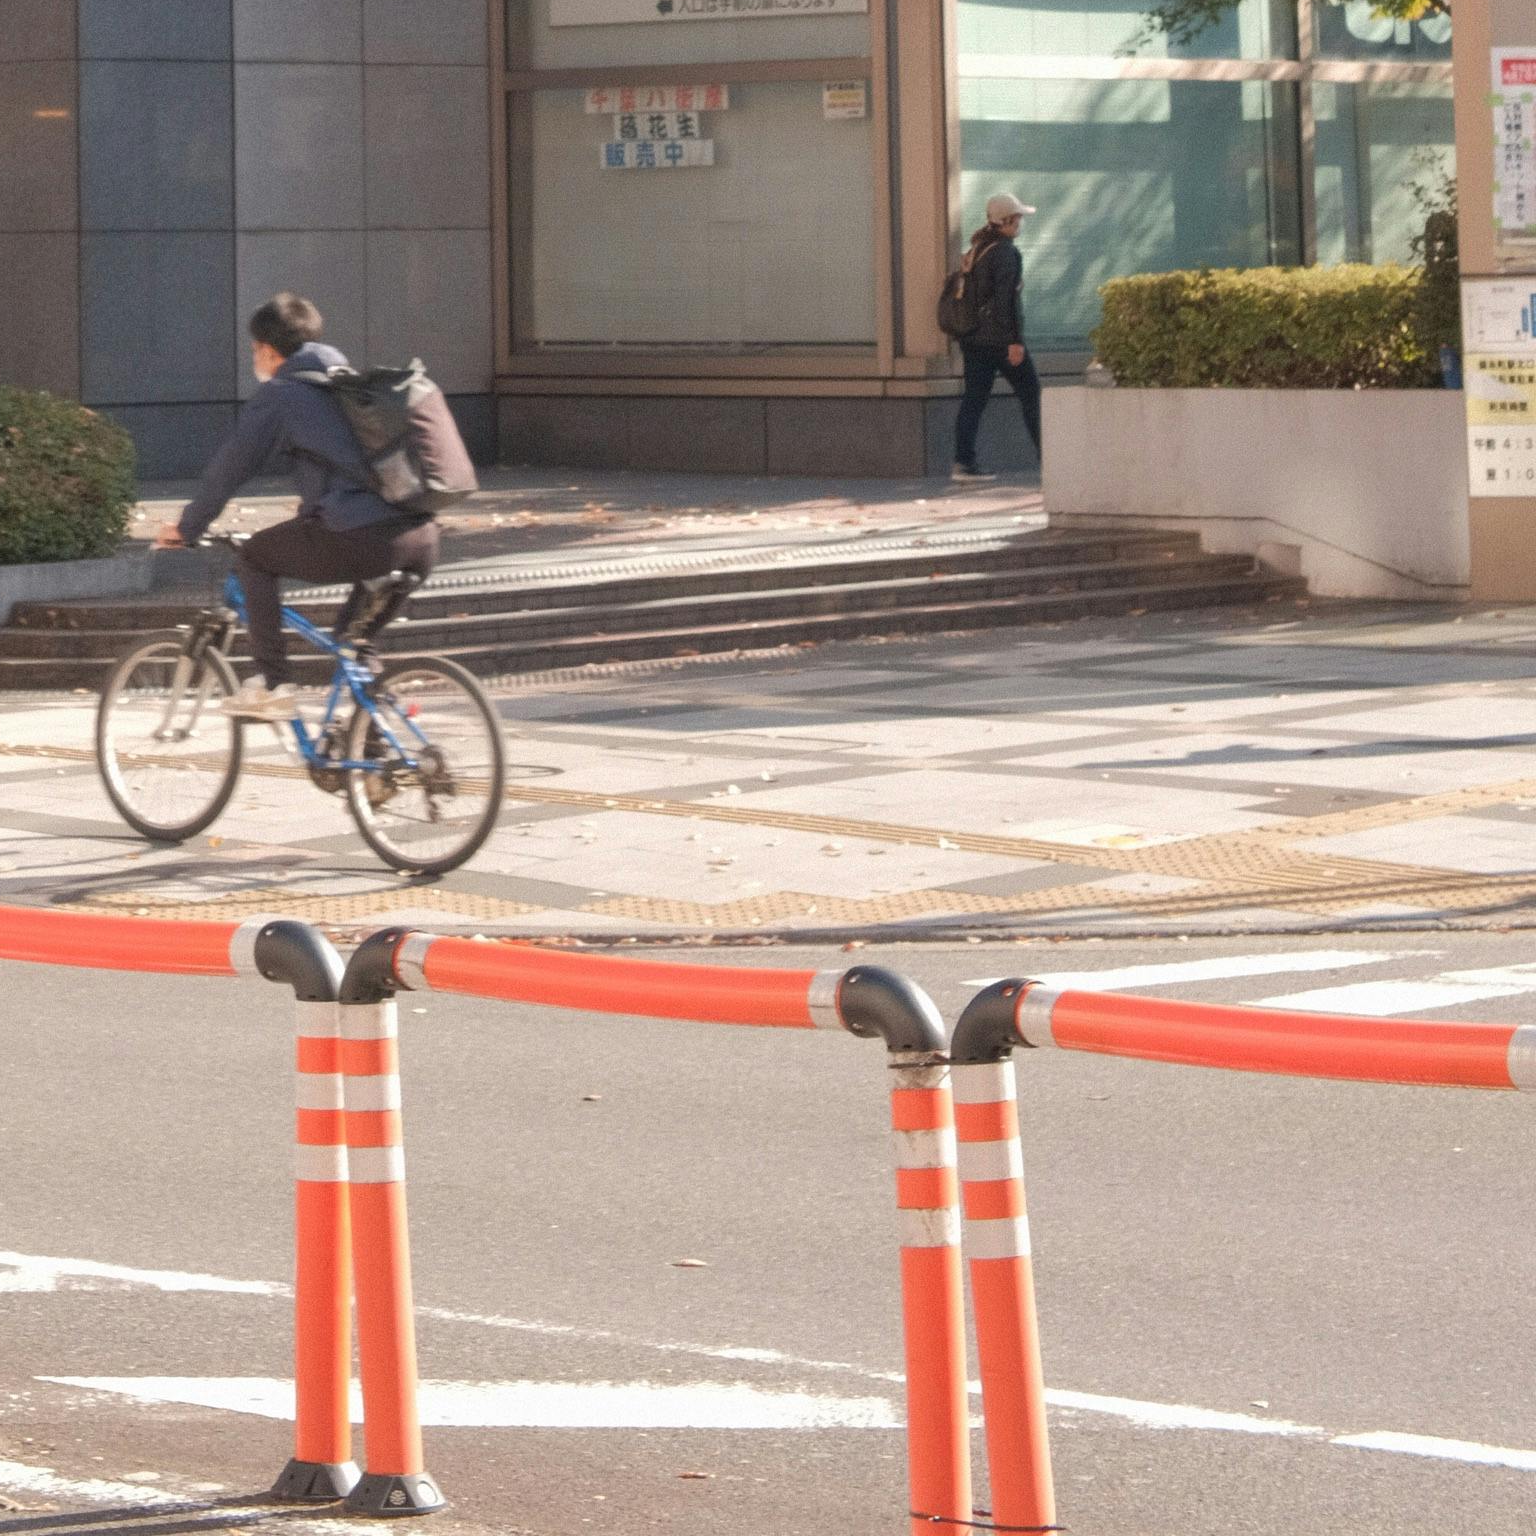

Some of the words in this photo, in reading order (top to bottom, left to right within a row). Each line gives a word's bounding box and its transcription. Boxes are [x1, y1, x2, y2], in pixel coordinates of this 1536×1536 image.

[619, 113, 695, 139] 落花生
[606, 141, 684, 168] 販売中
